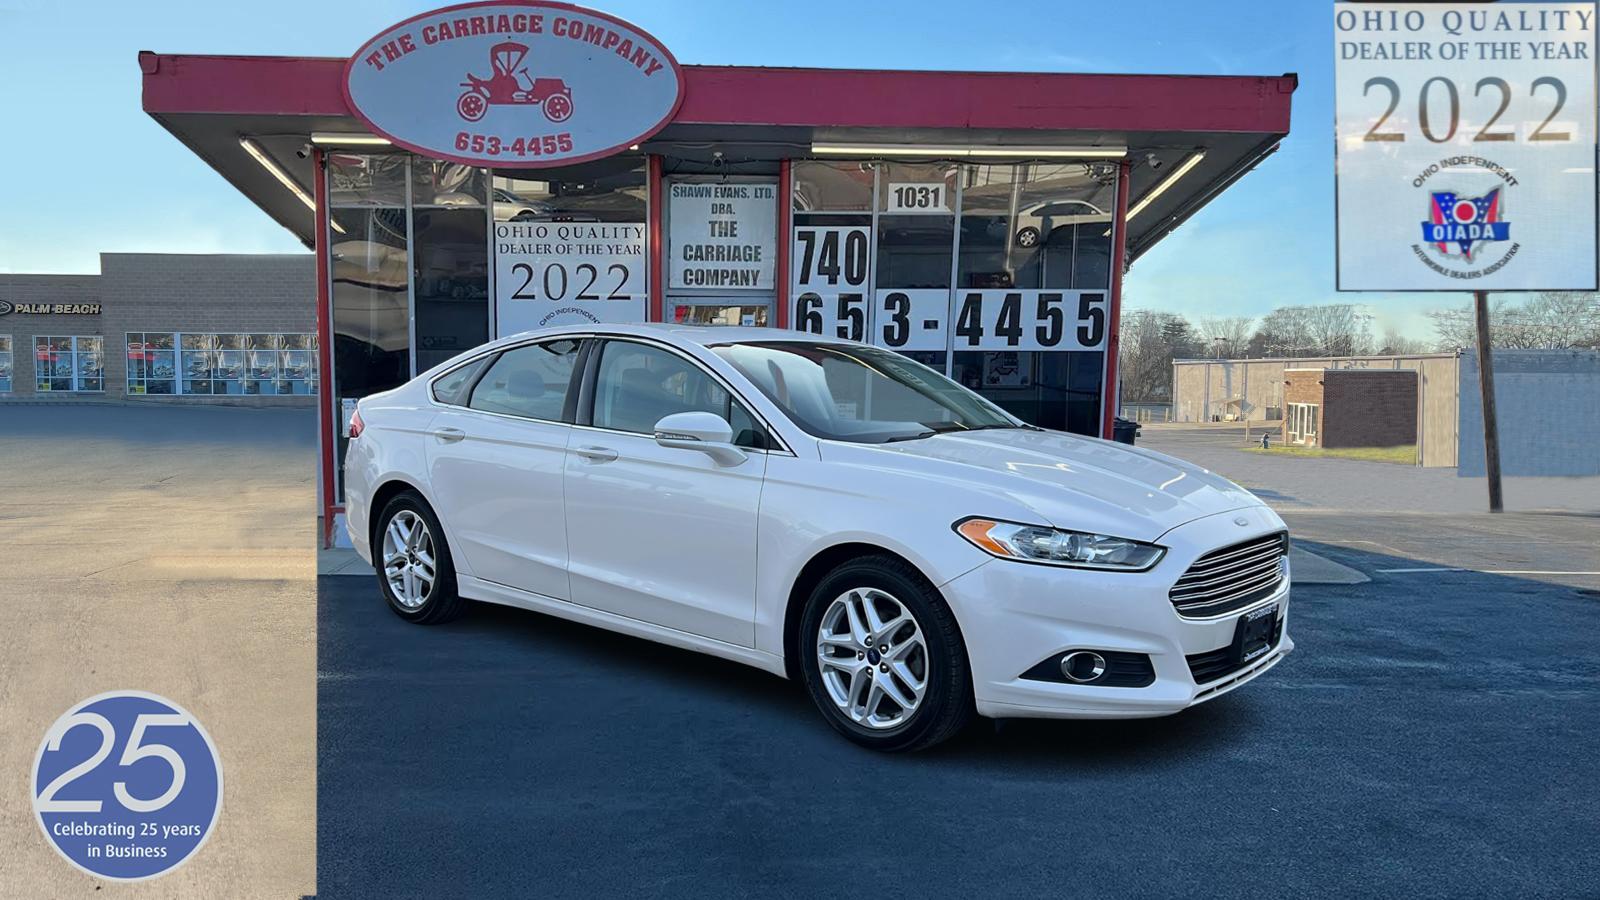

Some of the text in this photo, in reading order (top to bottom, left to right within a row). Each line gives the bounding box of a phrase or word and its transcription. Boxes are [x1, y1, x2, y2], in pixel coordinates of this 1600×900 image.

[1336, 9, 1593, 36] OHIO QUALITY
[366, 14, 665, 77] THE CARRIAGE COMPANY
[1340, 42, 1589, 60] DEALER OF THE YEAR
[1362, 76, 1571, 144] 2022
[455, 131, 573, 157] 653-4455
[1412, 155, 1519, 188] OHIO INDEPENDENT
[672, 186, 712, 199] SHAWN
[754, 186, 774, 199] LTD.
[894, 186, 941, 209] 1031
[711, 203, 736, 216] DBA.
[496, 226, 645, 242] OHIO QUALITY
[708, 220, 738, 238] THE
[1432, 224, 1495, 241] OIADA
[499, 243, 642, 256] DEALER OF THE YEAR
[683, 244, 762, 262] CARRIAGE
[797, 230, 868, 286] 740
[511, 262, 632, 301] 2022
[683, 268, 761, 287] COMPANY
[1448, 268, 1482, 280] DEALERS
[14, 304, 100, 314] PALM BEACH
[539, 306, 601, 326] OHIO INDEPENDEN
